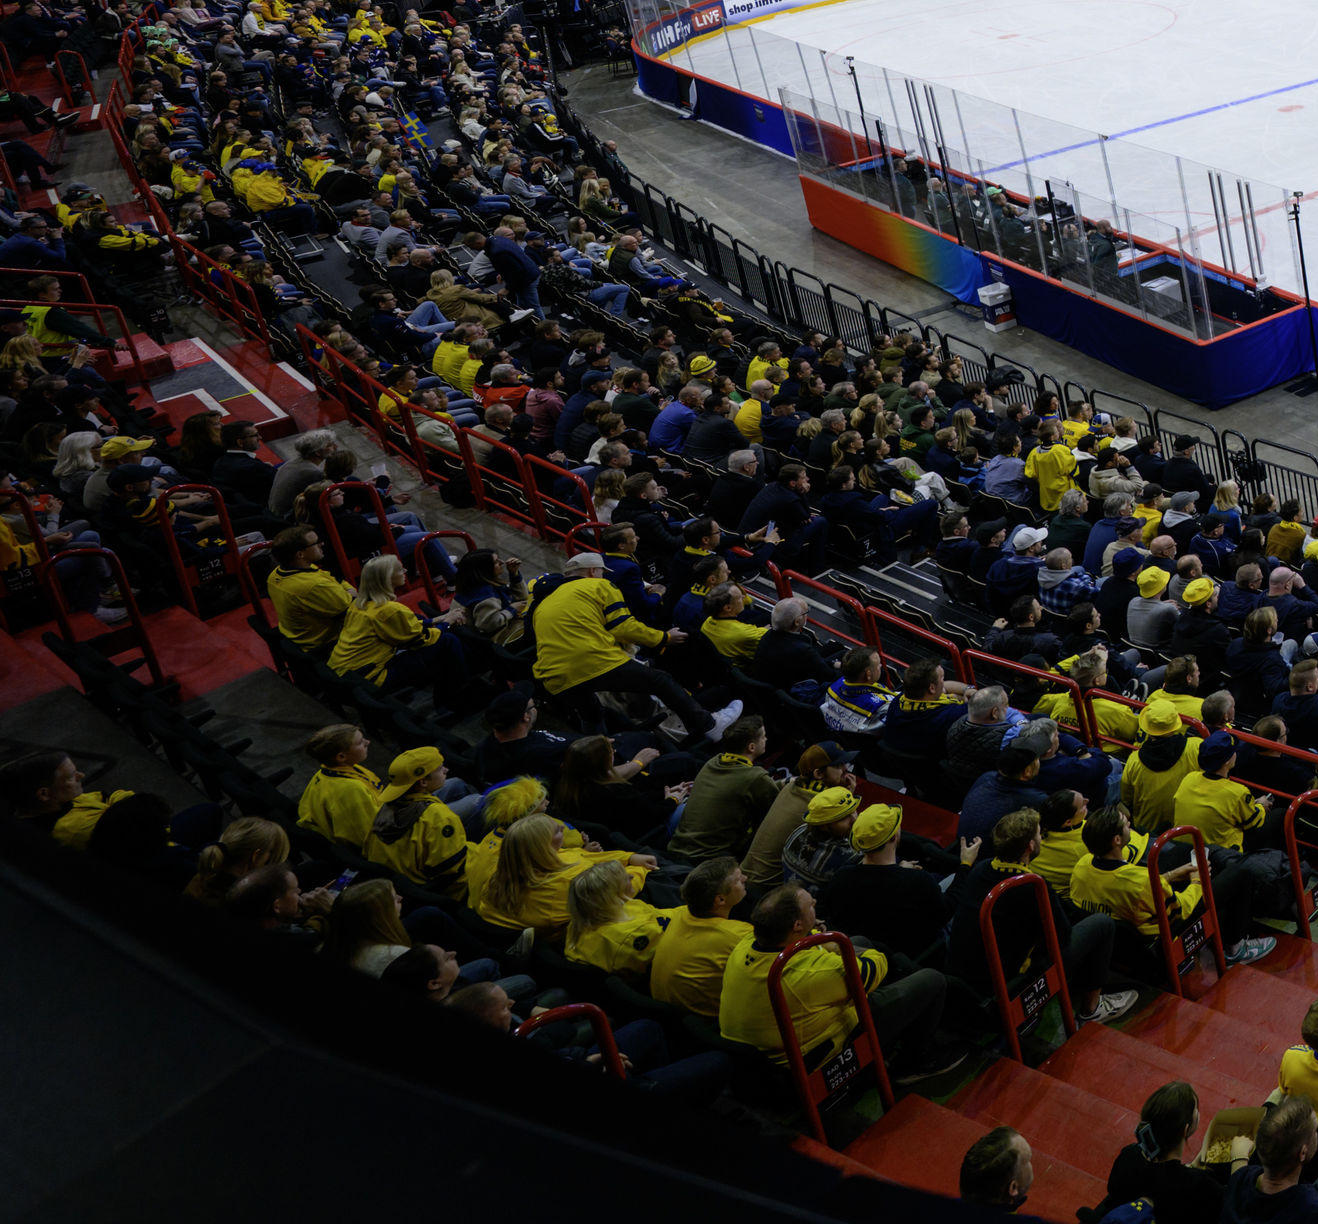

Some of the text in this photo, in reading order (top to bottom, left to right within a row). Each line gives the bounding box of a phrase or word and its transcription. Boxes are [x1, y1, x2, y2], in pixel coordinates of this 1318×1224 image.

[694, 9, 720, 27] LIVE
[1193, 920, 1203, 934] 11
[1033, 978, 1046, 993] 12
[837, 1047, 854, 1065] 13
